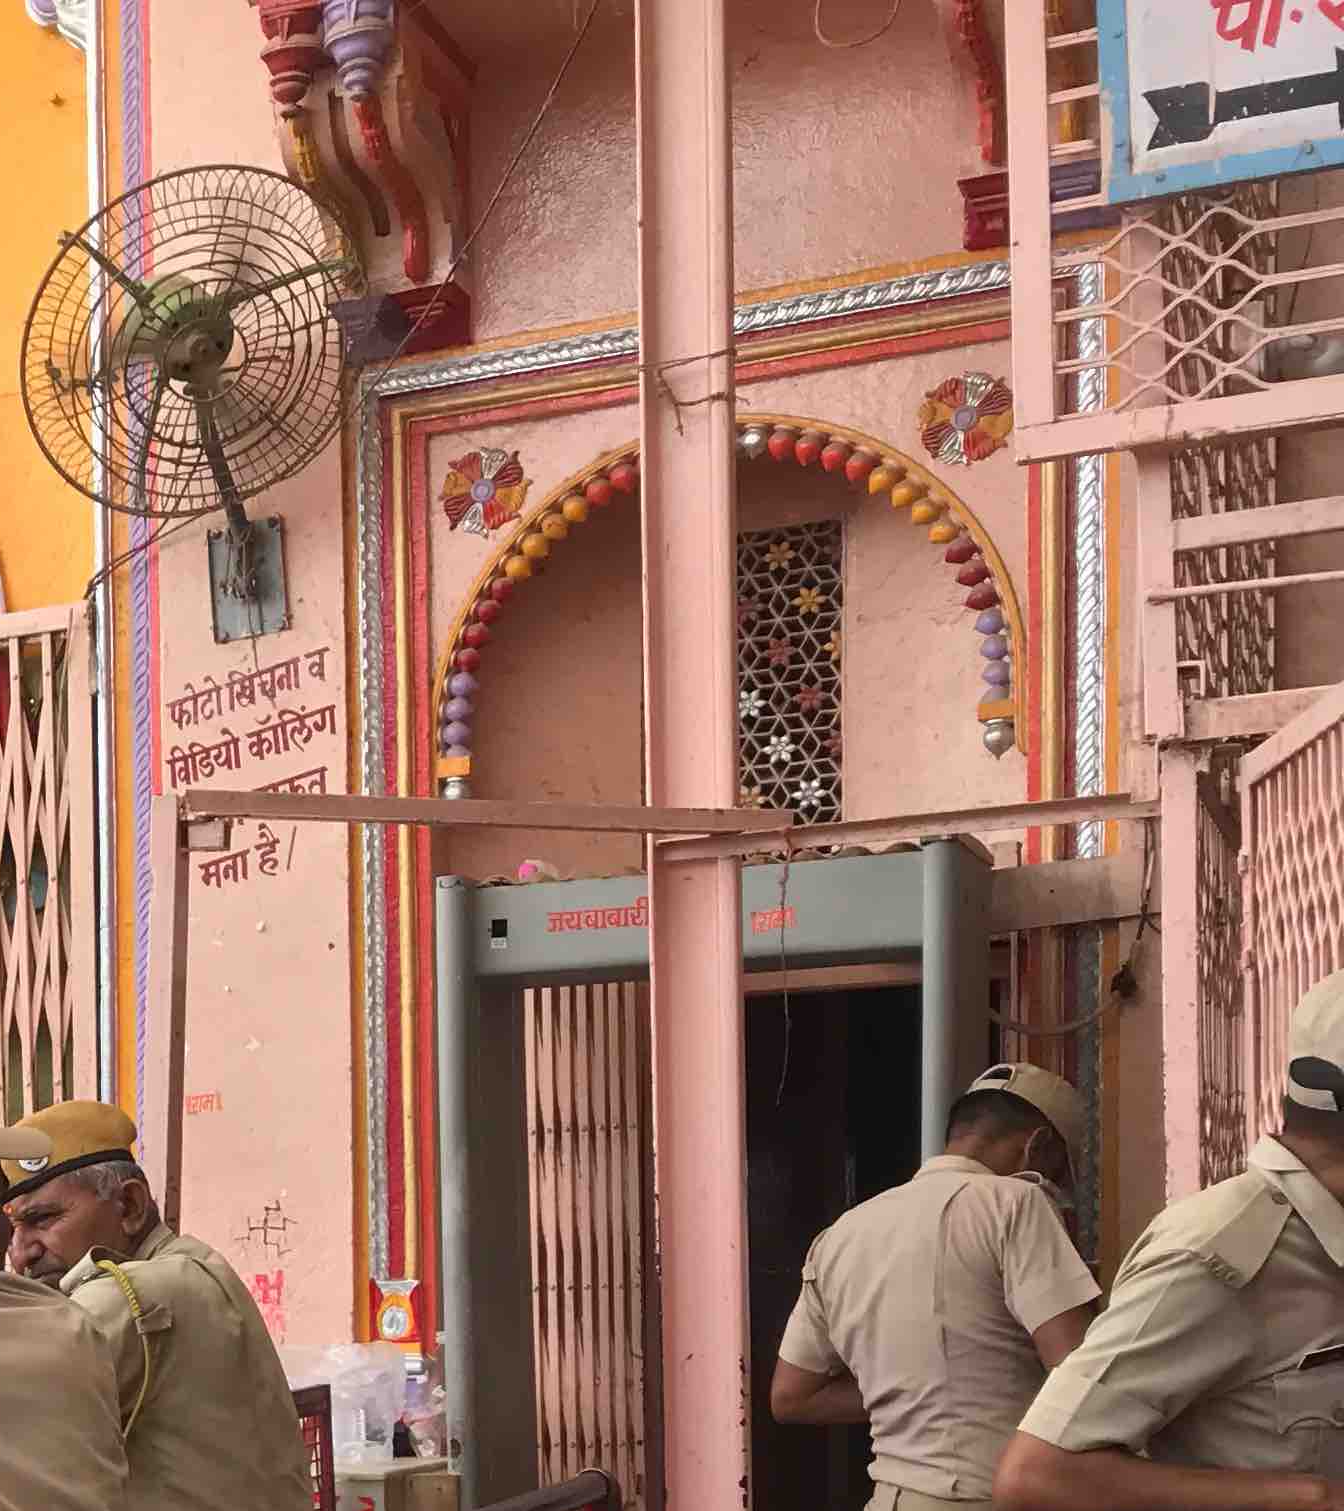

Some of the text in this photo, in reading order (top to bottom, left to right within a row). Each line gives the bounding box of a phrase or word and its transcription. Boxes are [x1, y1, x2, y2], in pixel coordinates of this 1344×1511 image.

[166, 677, 223, 730] फोटो
[303, 646, 330, 681] व
[246, 703, 337, 760] कॉलिंग
[198, 850, 250, 888] मना
